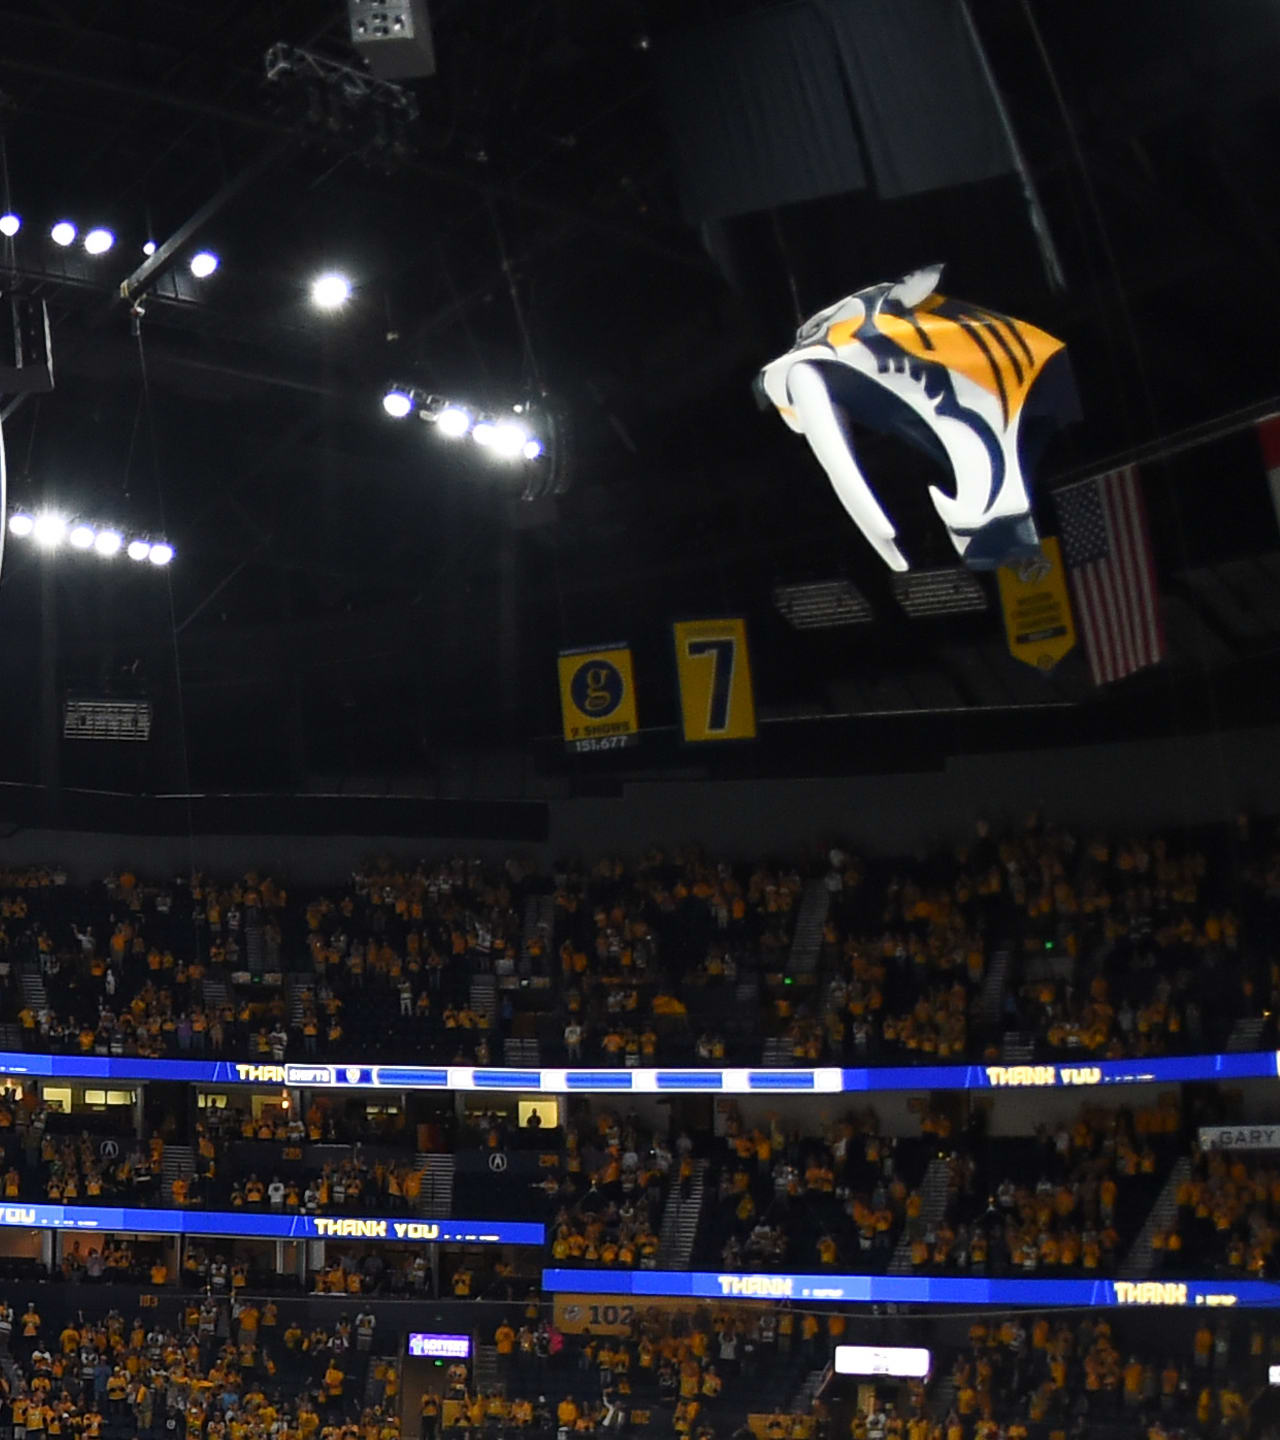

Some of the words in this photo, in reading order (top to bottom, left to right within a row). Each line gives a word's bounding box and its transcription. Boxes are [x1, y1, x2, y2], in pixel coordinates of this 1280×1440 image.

[686, 637, 737, 734] 7
[574, 735, 629, 752] 151,677
[235, 1064, 286, 1082] THAN
[987, 1065, 1056, 1087] THANK
[314, 1217, 387, 1237] THANK
[394, 1222, 439, 1239] YOU
[718, 1276, 793, 1296] THANK
[1114, 1282, 1187, 1304] THANK
[588, 1304, 635, 1325] 102
